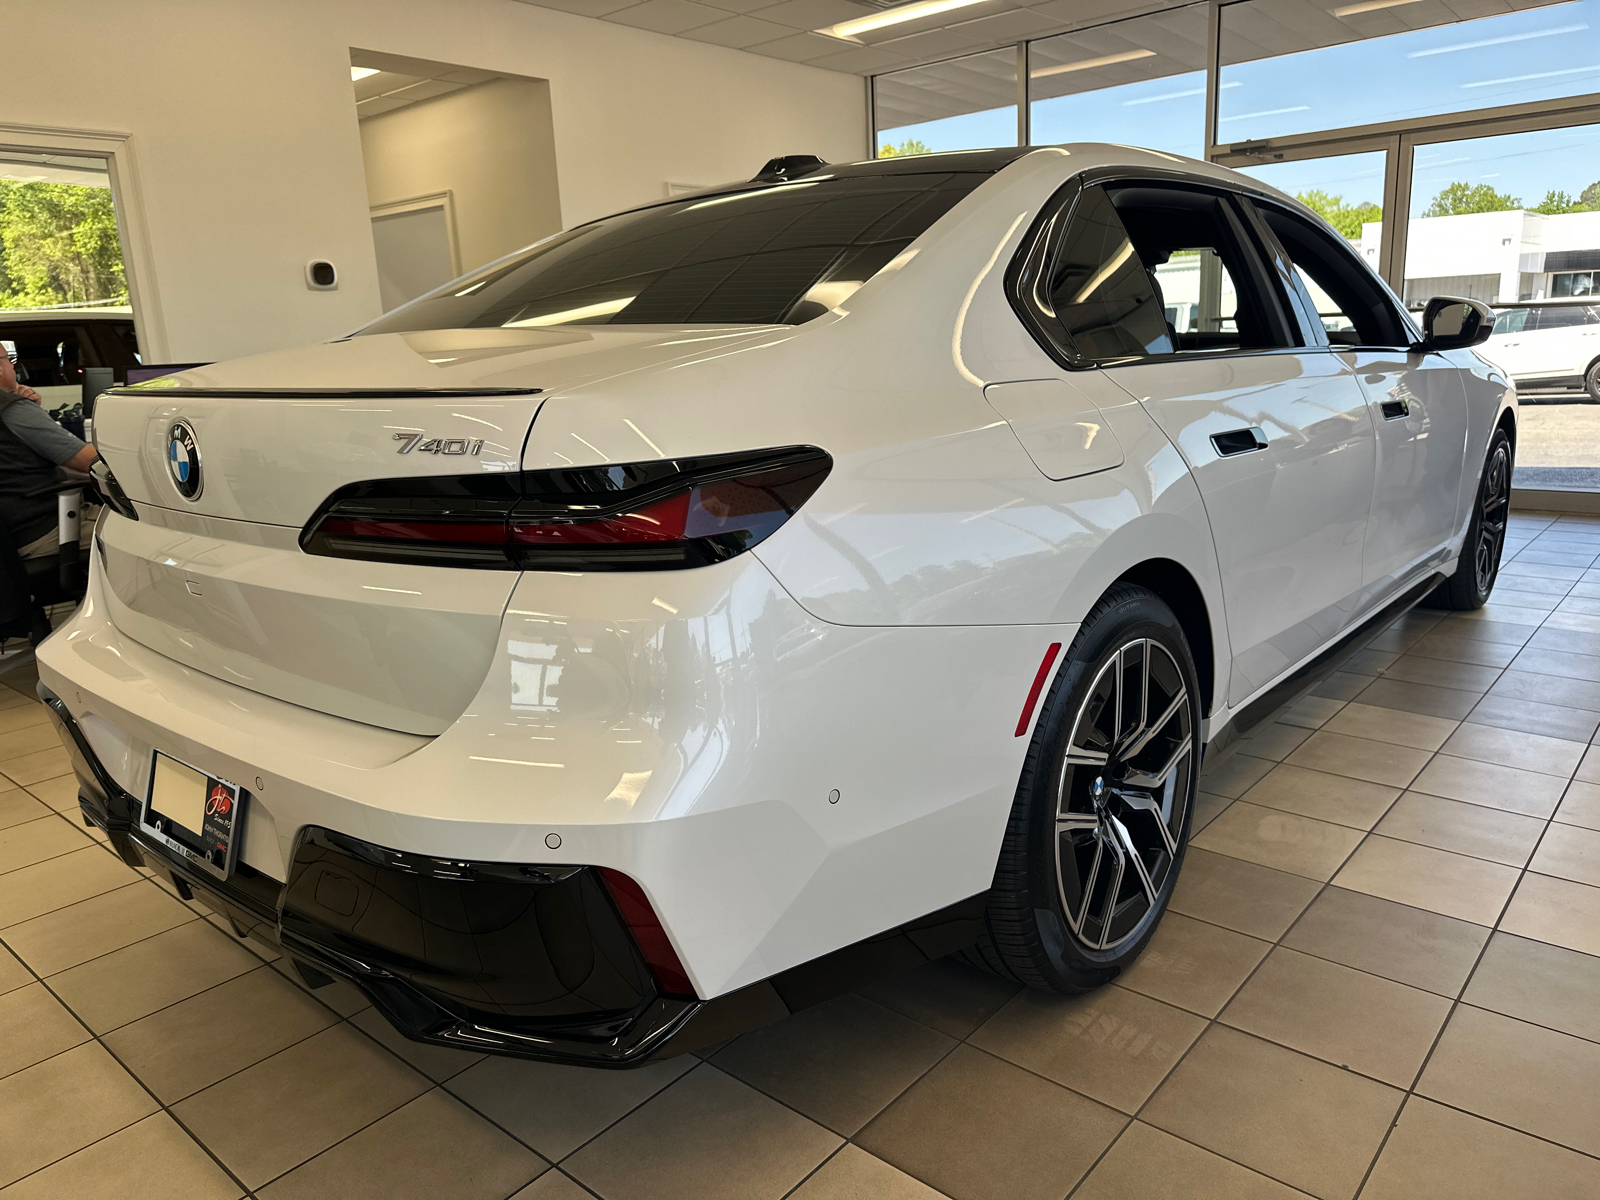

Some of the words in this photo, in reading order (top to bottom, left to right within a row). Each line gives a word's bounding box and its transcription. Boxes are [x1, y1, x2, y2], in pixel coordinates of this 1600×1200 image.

[167, 425, 194, 452] BMW
[392, 432, 484, 456] 740i
[217, 842, 227, 852] GMC
